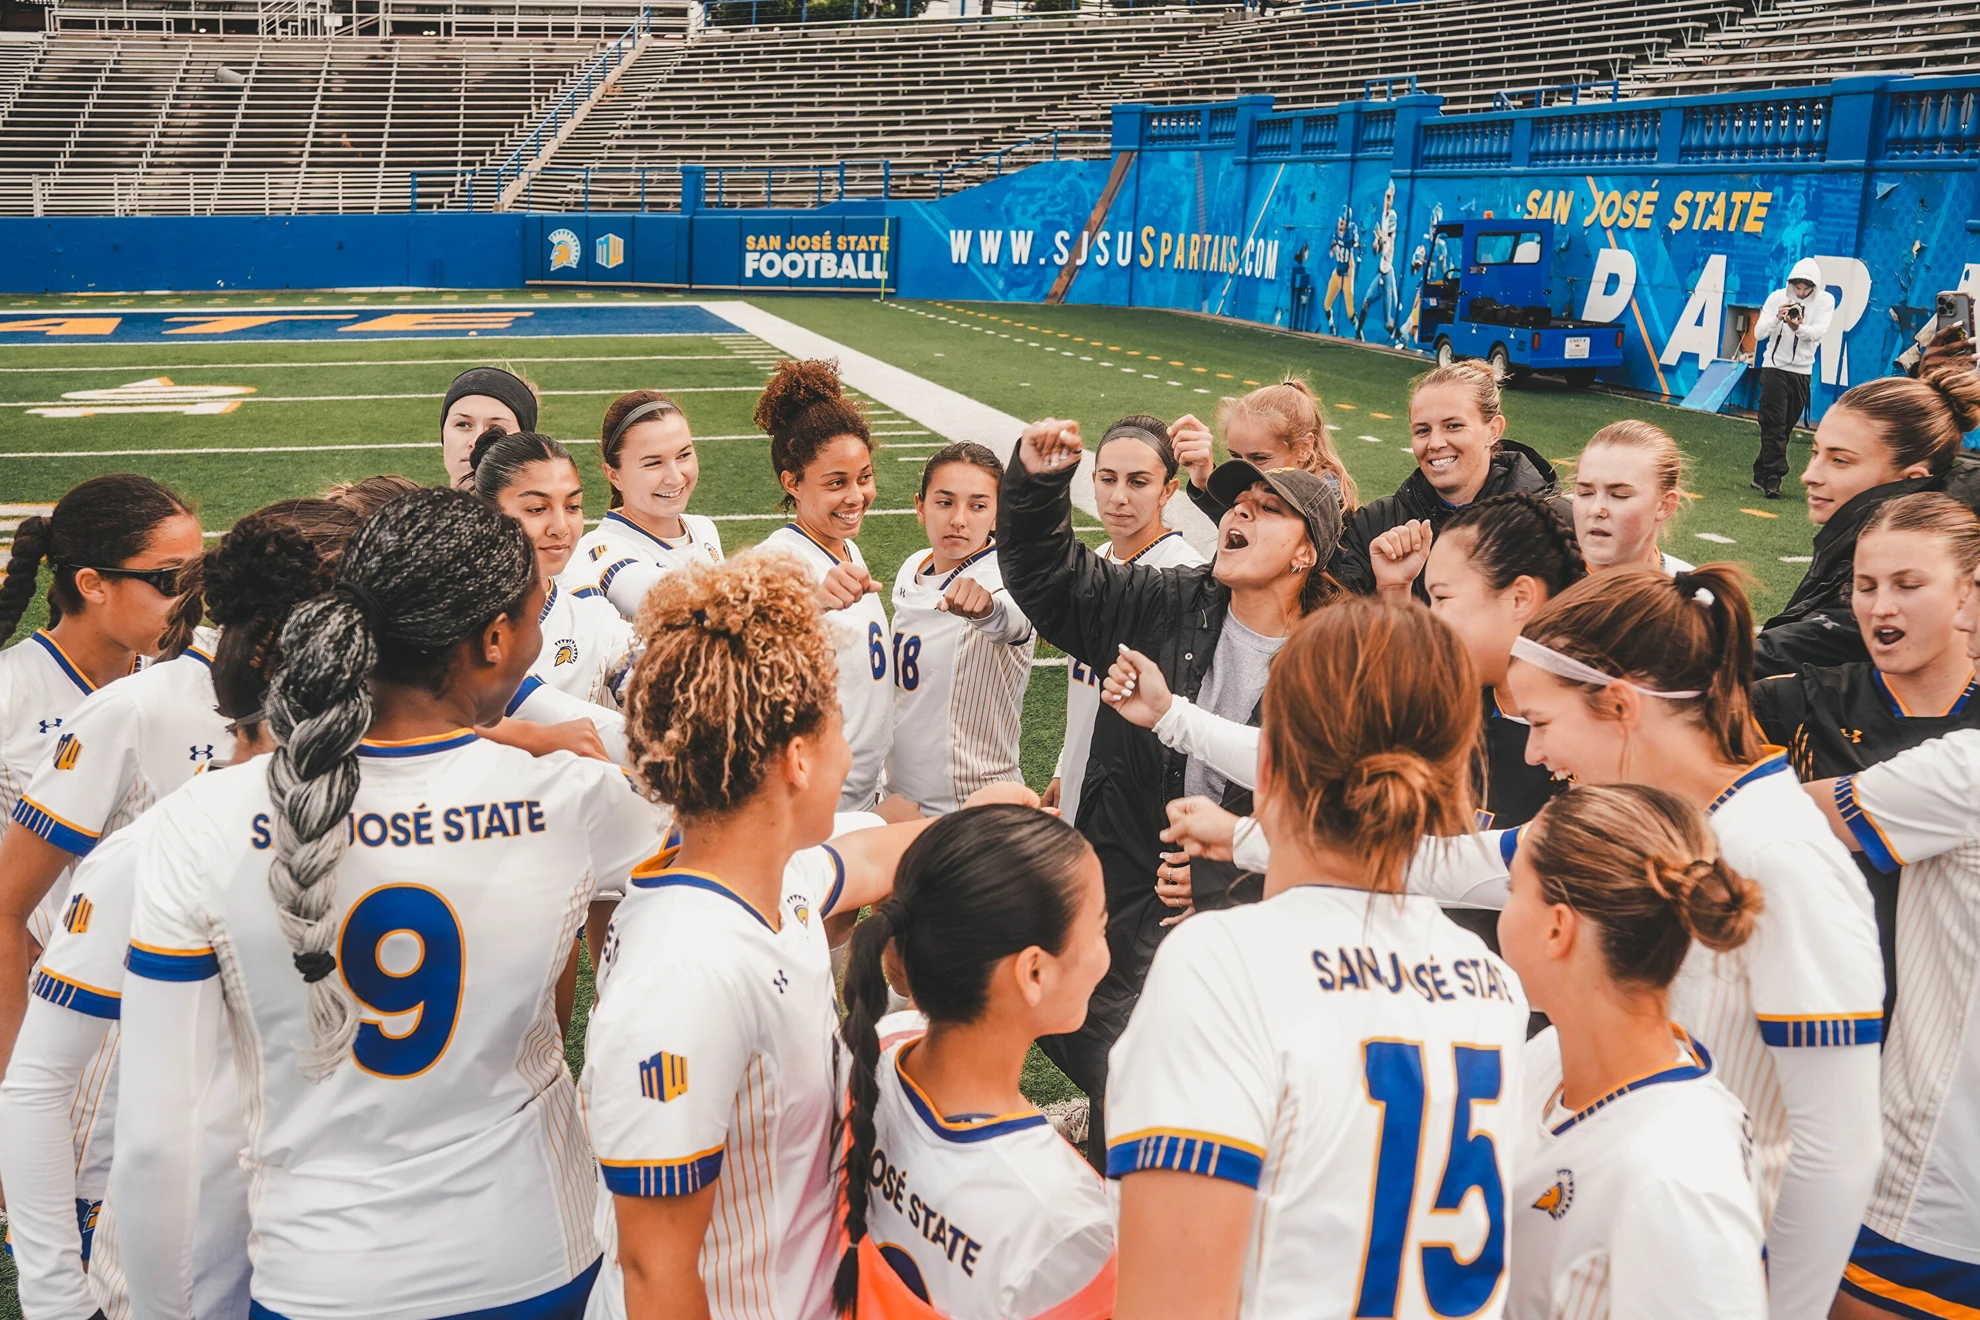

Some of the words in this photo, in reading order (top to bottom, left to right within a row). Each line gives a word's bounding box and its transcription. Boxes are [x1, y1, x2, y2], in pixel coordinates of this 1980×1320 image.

[1523, 189, 1575, 226] SAN
[1583, 179, 1660, 230] JOSÉ
[1668, 190, 1773, 233] STATE
[745, 235, 781, 251] SAN
[785, 230, 832, 251] JOSÉ
[837, 235, 890, 252] STATE
[745, 252, 889, 280] FOOTBALL
[868, 620, 887, 681] 6
[892, 630, 922, 692] 18
[443, 800, 546, 843] STATE
[337, 882, 466, 1080] 9
[1311, 947, 1385, 991] SAN
[1351, 1036, 1506, 1320] 15
[869, 1149, 908, 1215] OSÉ
[908, 1192, 983, 1279] STATE
